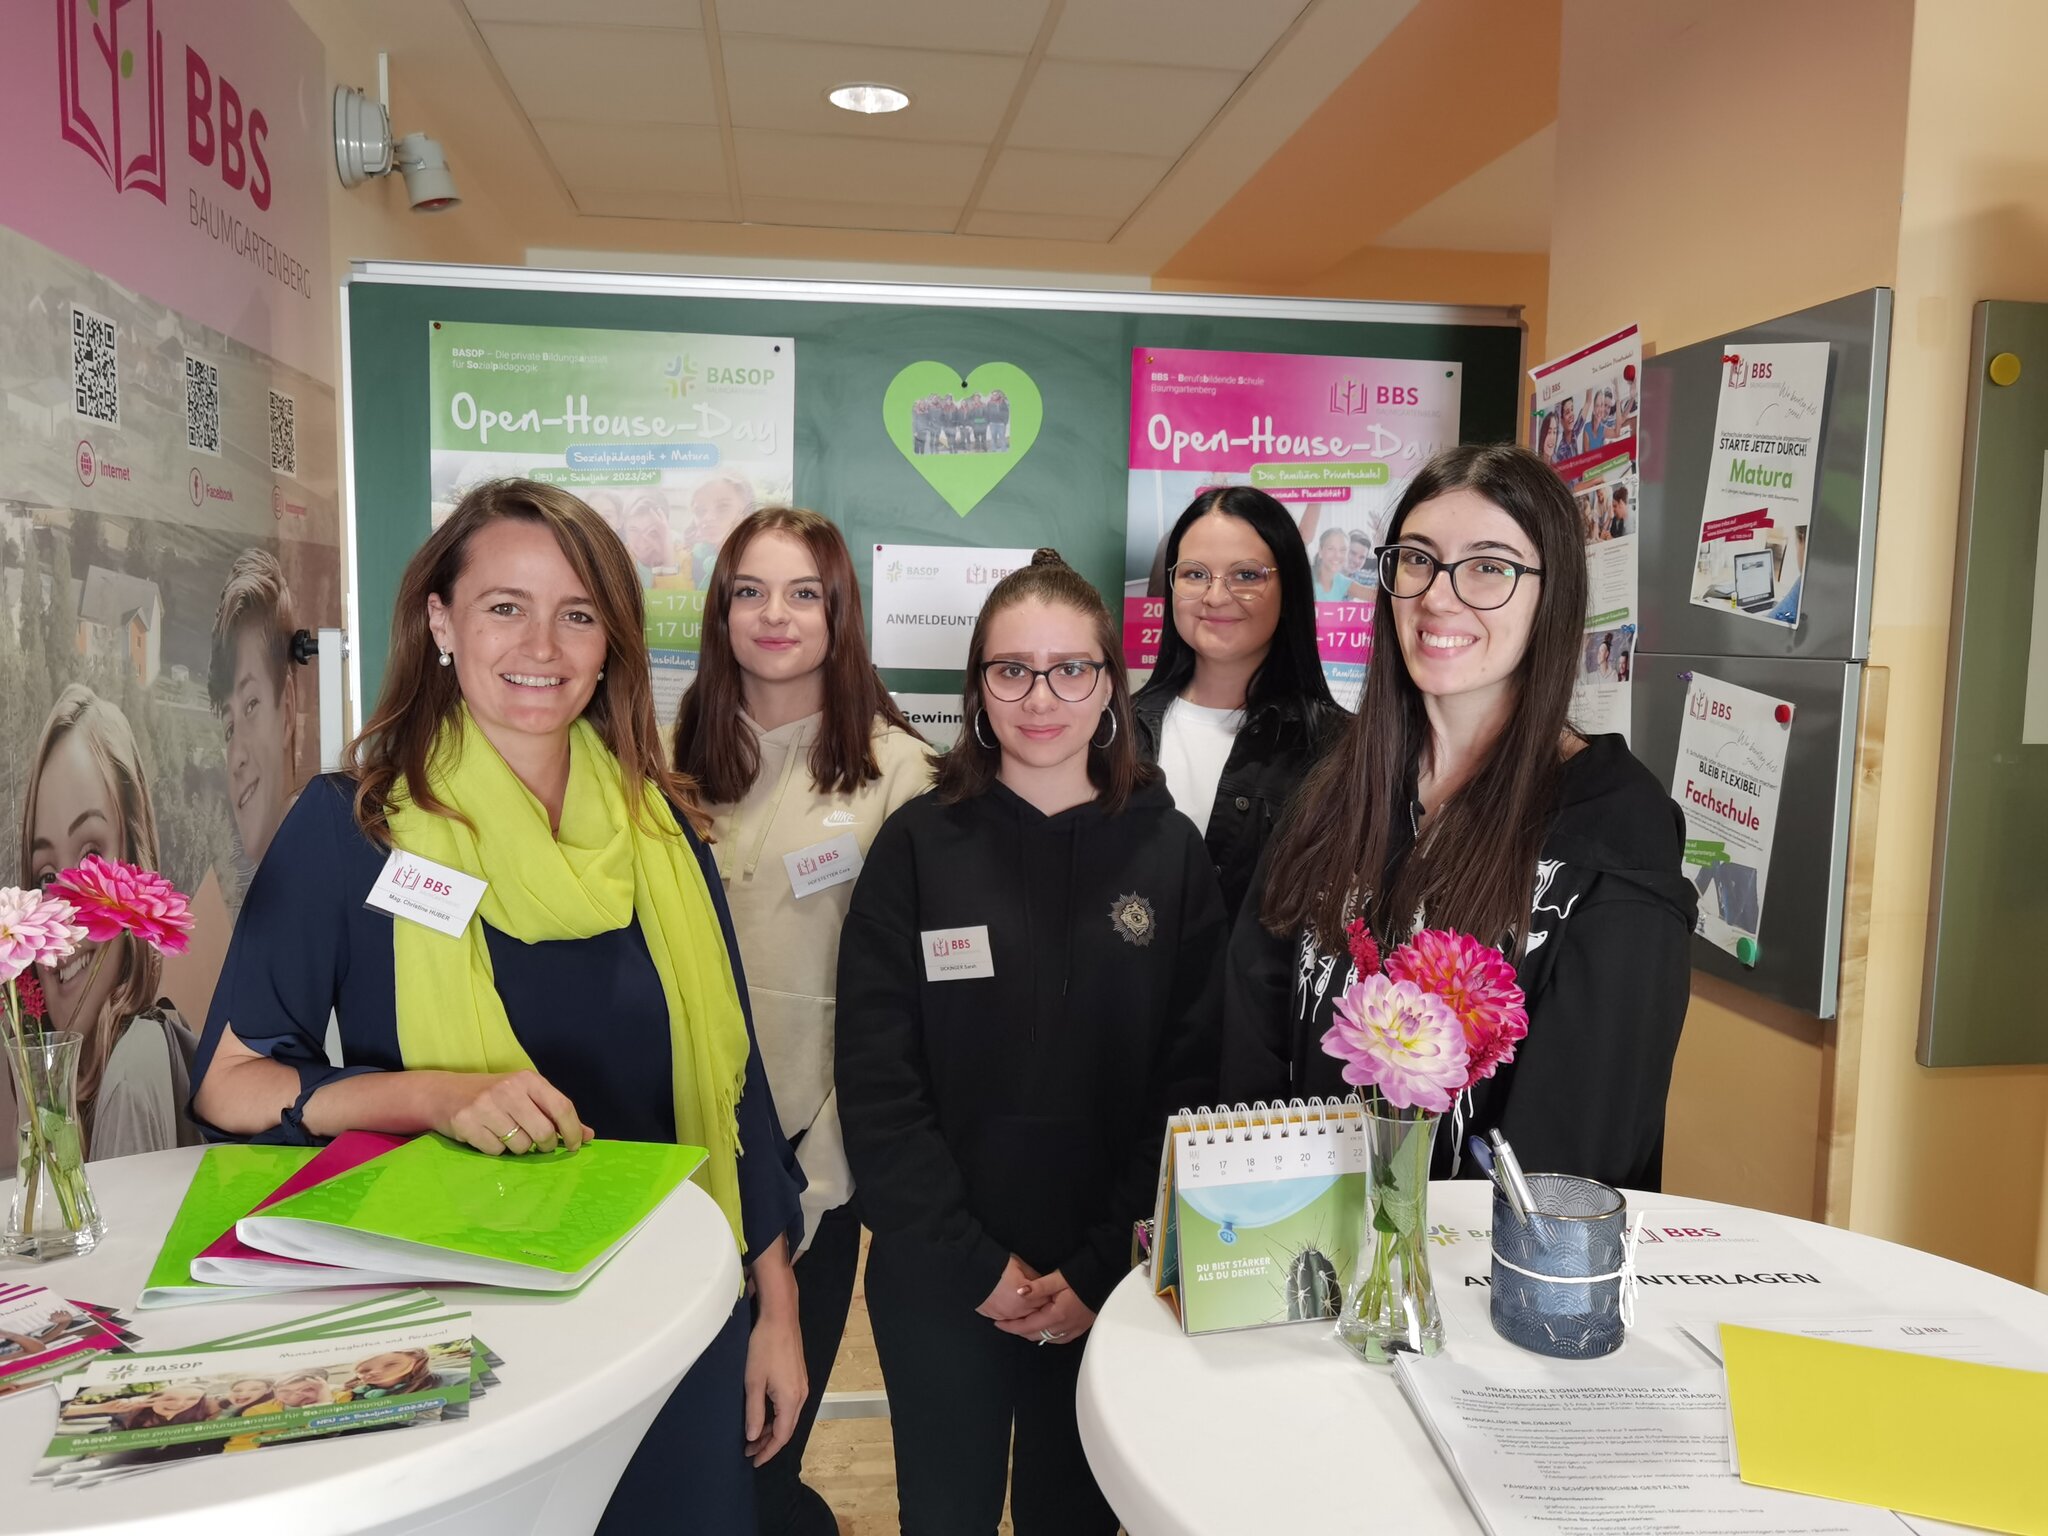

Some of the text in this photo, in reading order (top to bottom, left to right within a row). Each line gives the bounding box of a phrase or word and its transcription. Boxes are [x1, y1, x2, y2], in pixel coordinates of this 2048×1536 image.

[186, 44, 271, 211] BBS
[189, 188, 312, 299] BAUMGARTENBERG
[452, 347, 484, 358] BASOP
[494, 350, 509, 360] Die
[510, 352, 540, 362] private
[452, 359, 538, 373] für Sozialpädagogik
[1752, 363, 1773, 378] BBS
[707, 367, 775, 385] BASOP
[1151, 372, 1264, 387] BBS Berufsbildende Schule
[1151, 384, 1216, 397] Baumgartenberg
[1376, 386, 1419, 406] BBS
[451, 392, 777, 456] Open-House-Day
[1719, 438, 1807, 456] STARTE JETZT DURCH!
[573, 451, 655, 465] Sozialpädagogik
[671, 449, 709, 461] Matura
[100, 460, 131, 482] Internet
[556, 474, 567, 483] ab
[570, 472, 609, 485] Schuljahr
[1257, 468, 1381, 481] Die familiäre Privatschule!
[1729, 458, 1793, 488] Matura
[206, 483, 233, 503] Facebook
[907, 567, 940, 576] BASOP
[667, 595, 687, 611] 17
[1337, 607, 1356, 622] 17
[656, 622, 702, 639] 17 Uh
[1327, 632, 1347, 648] 17
[1711, 701, 1732, 720] BBS
[1698, 761, 1719, 780] BLEIB
[1720, 770, 1761, 798] FLEXIBEL!
[1685, 780, 1760, 831] Fachschule
[830, 810, 855, 822] NIKE
[818, 850, 839, 864] BBS
[423, 878, 452, 896] BBS
[388, 893, 450, 921] Mag. Christine HUBER
[952, 938, 971, 950] BBS
[1191, 1148, 1363, 1171] 16 17 18 19 20 21 22
[1663, 1227, 1722, 1238] BBS
[1196, 1257, 1271, 1273] DU BIST STÄRKER
[1198, 1266, 1269, 1282] ALS DU DENKST.
[280, 1348, 330, 1358] Menschen
[335, 1341, 381, 1352] begleiten
[144, 1361, 203, 1373] BASOP
[1462, 1389, 1556, 1399] BILDUNGSANSTALT
[72, 1435, 117, 1445] BASOP
[152, 1427, 194, 1437] private
